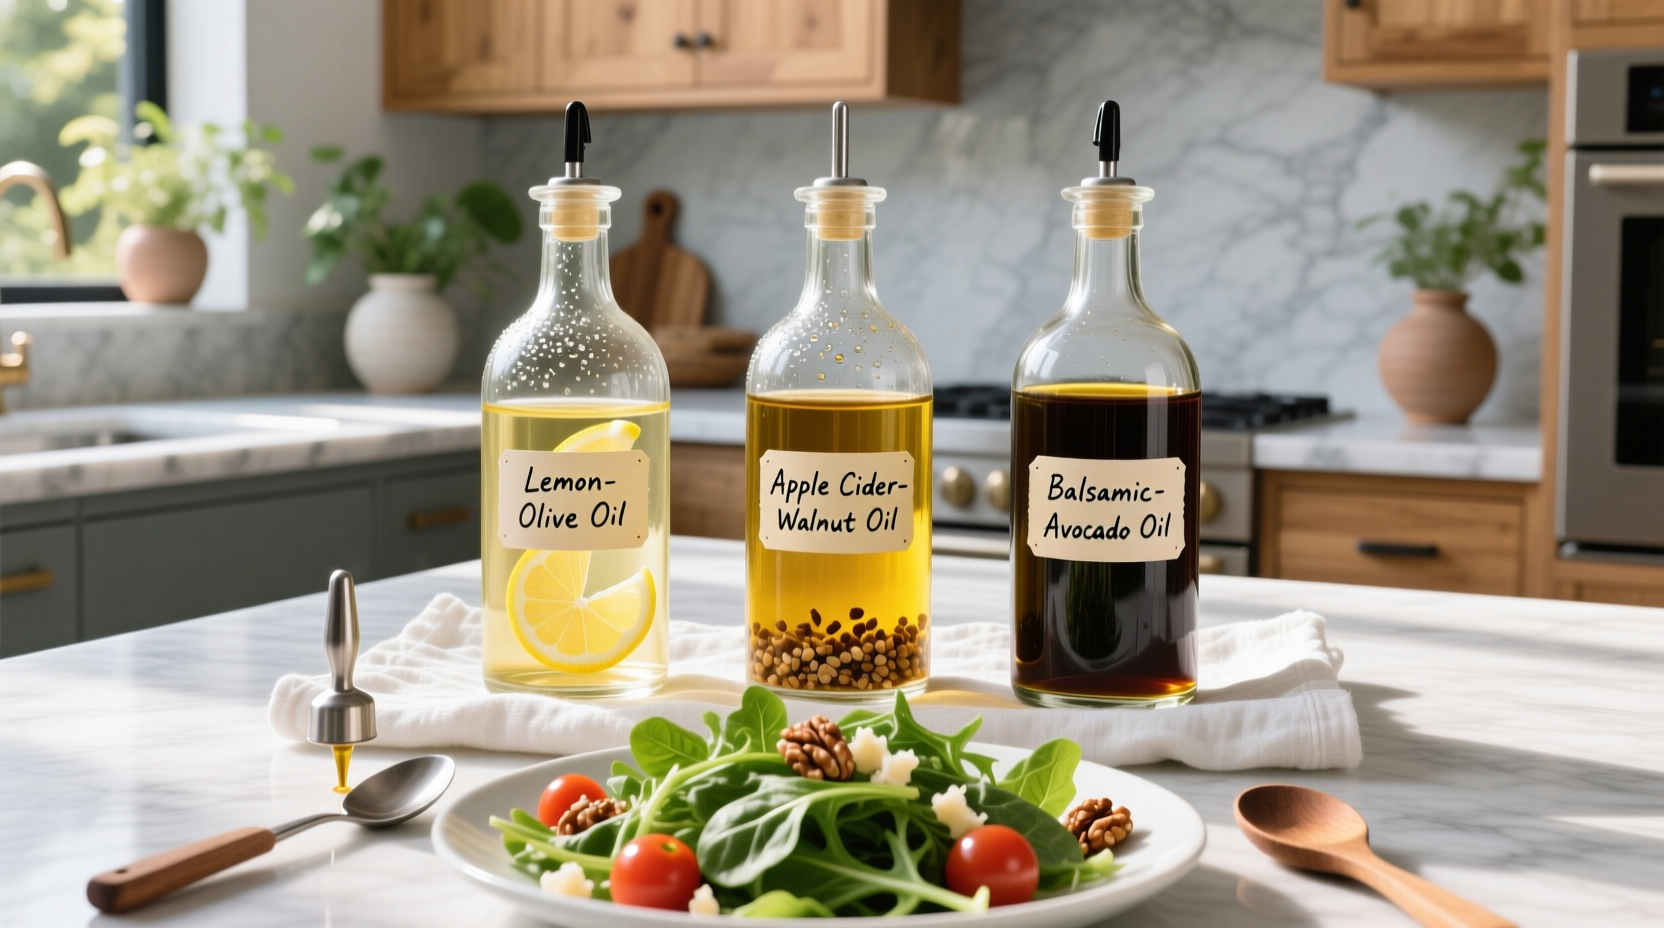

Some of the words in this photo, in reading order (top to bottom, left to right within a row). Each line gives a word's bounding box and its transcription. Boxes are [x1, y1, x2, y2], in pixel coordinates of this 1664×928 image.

[524, 465, 616, 493] Lemon-
[769, 468, 830, 504] Apple
[839, 470, 908, 497] Cider-
[1047, 473, 1165, 502] Balsamic-
[518, 501, 579, 529] Olive
[590, 500, 627, 528] Oil
[777, 506, 857, 533] Walnut
[866, 506, 899, 532] Oil
[1043, 511, 1131, 540] Avocado
[1139, 511, 1172, 539] Oil
